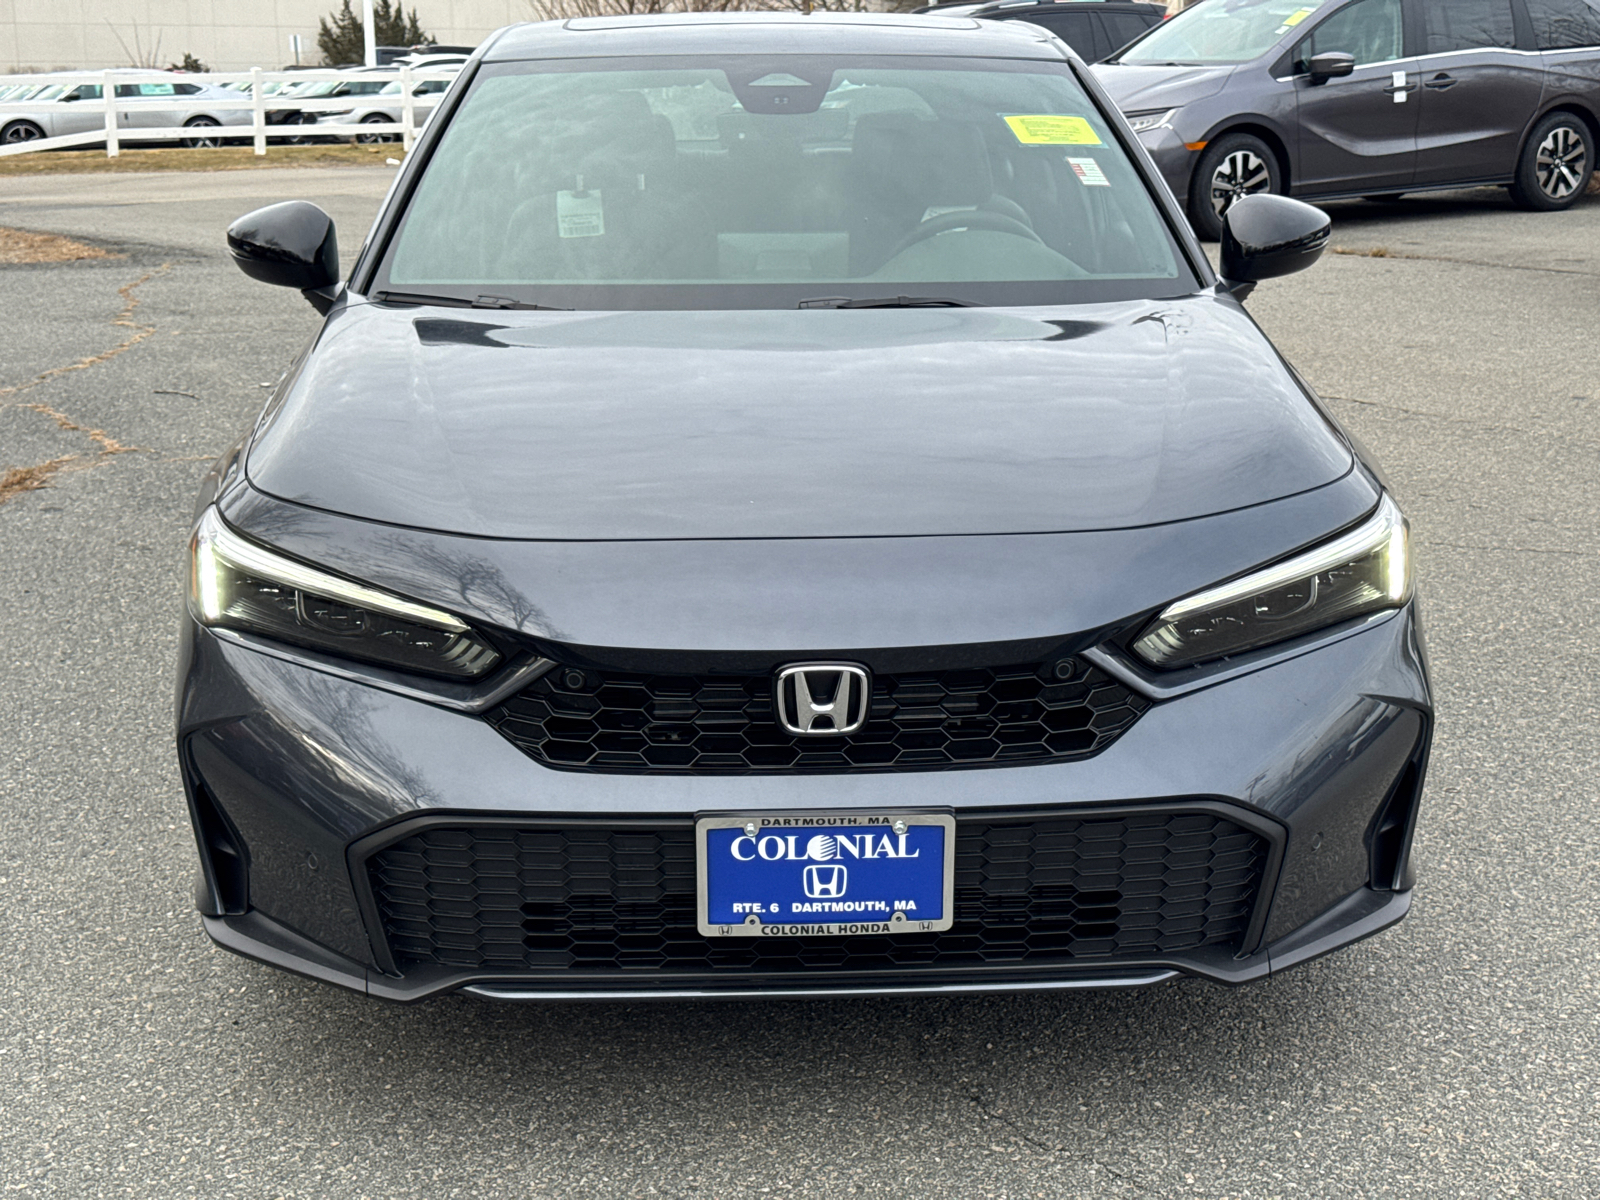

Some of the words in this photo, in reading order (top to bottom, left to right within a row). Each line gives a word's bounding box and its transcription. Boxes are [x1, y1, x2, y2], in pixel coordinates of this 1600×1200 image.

[761, 817, 863, 827] DARTMOUTH,
[868, 816, 891, 825] MA
[730, 833, 920, 862] COLONIAL
[732, 903, 767, 913] RTE.
[769, 903, 780, 913] 6
[791, 901, 890, 913] DARTMOUTH,
[894, 900, 917, 911] MA
[761, 924, 834, 935] COLONIAL
[838, 923, 891, 935] HONDA
